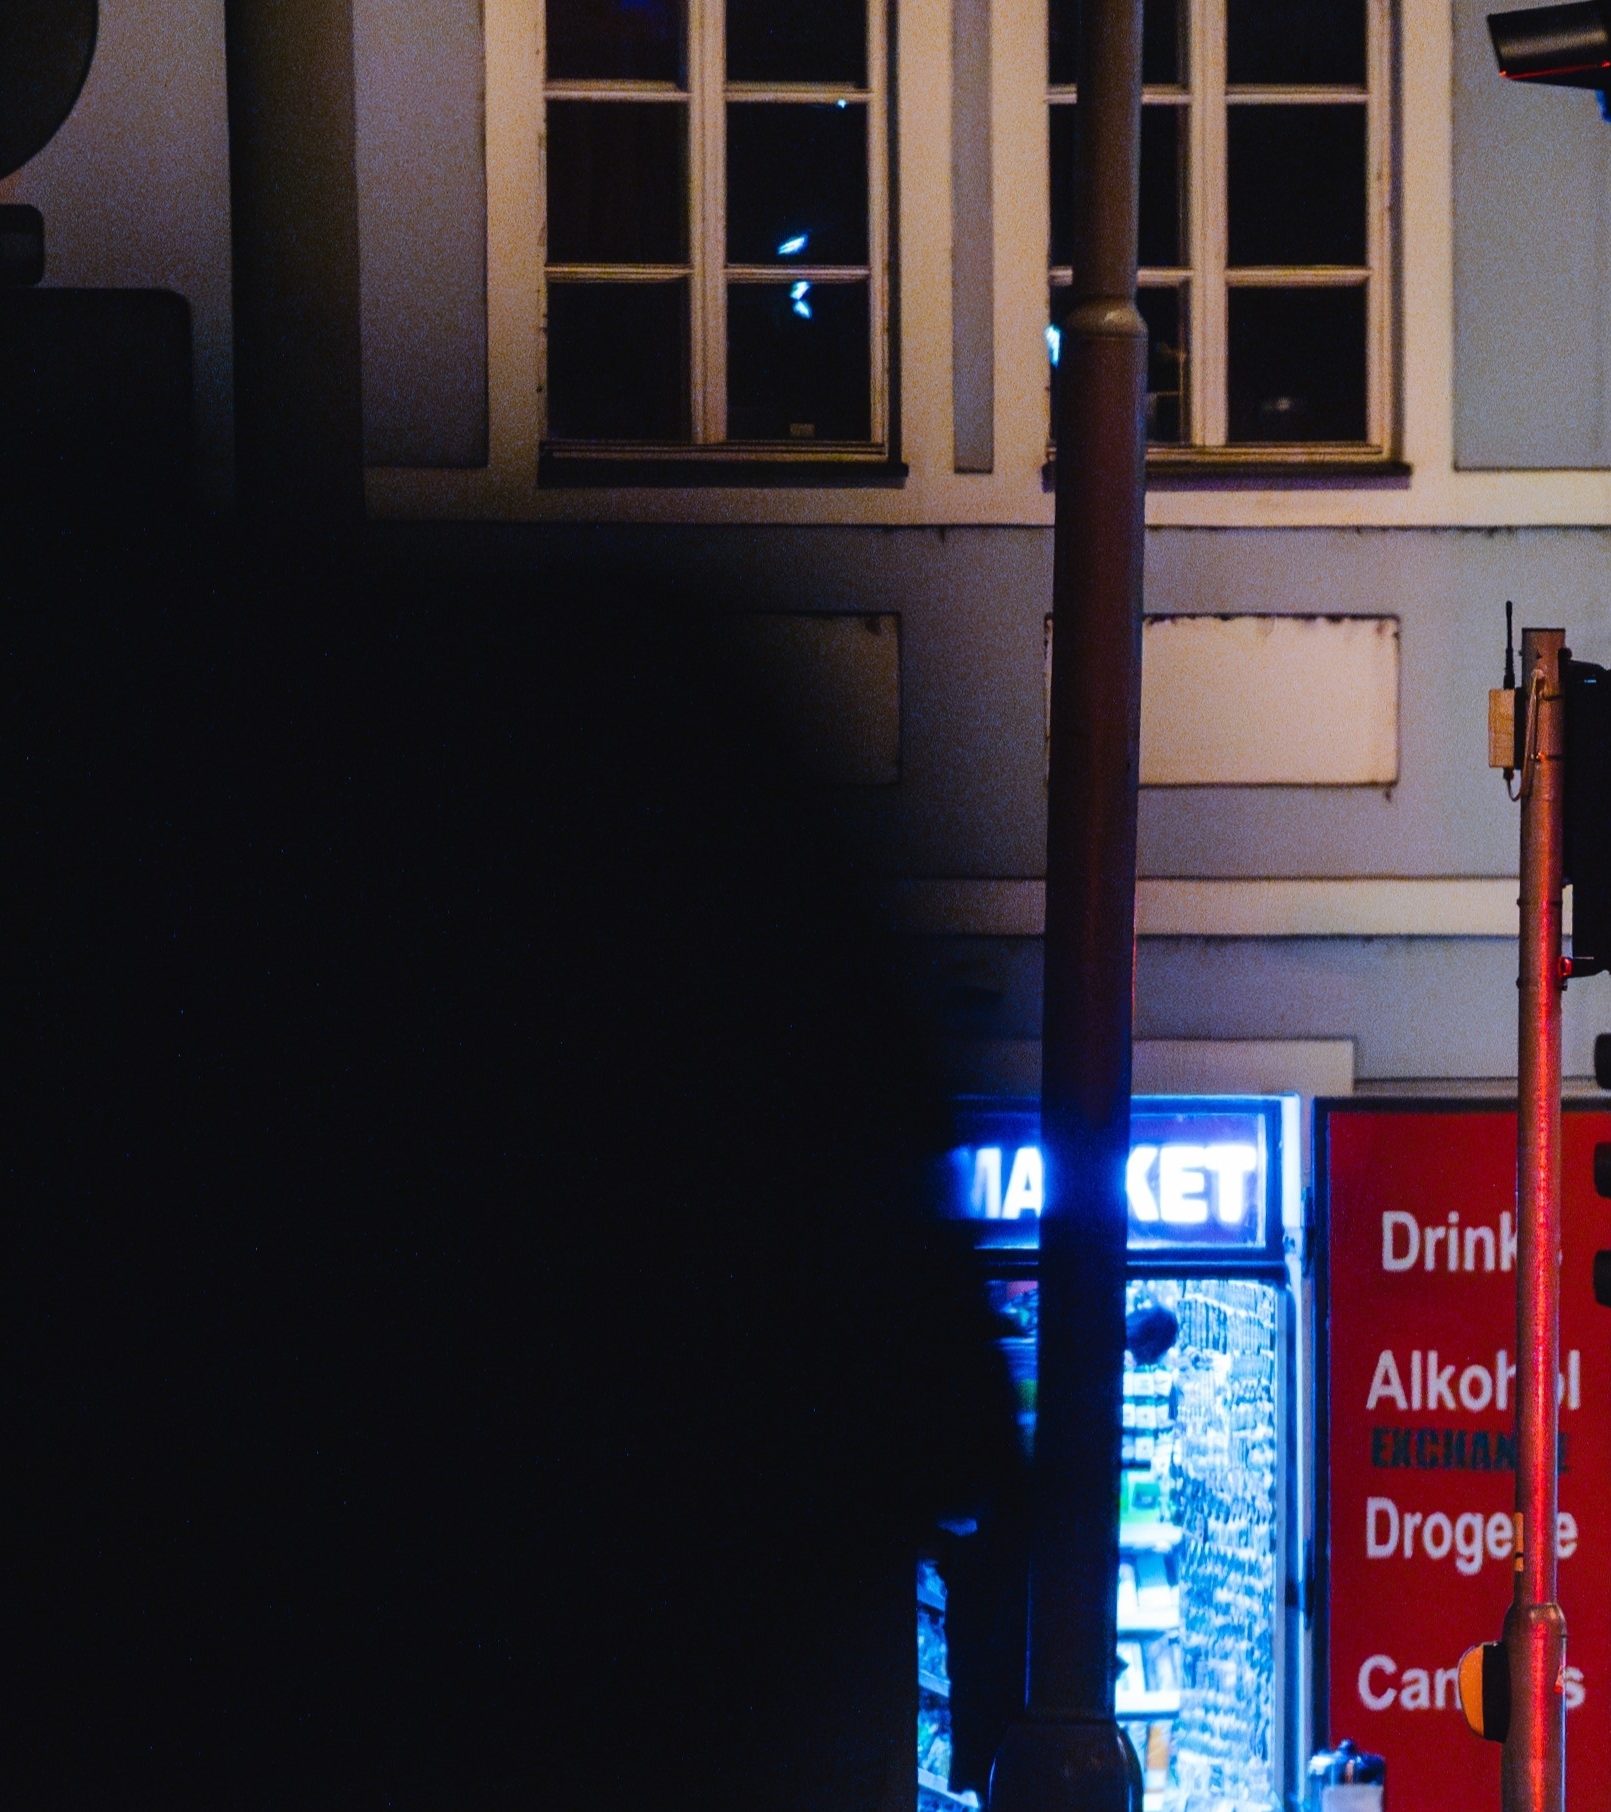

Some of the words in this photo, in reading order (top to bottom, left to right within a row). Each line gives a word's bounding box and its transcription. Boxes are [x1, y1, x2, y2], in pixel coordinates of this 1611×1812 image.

[965, 1145, 1257, 1222] MAKET
[1382, 1210, 1563, 1273] Drink
[1366, 1349, 1581, 1412] Alkohl
[1372, 1425, 1570, 1474] EXCHANE
[1366, 1497, 1579, 1576] Drogee
